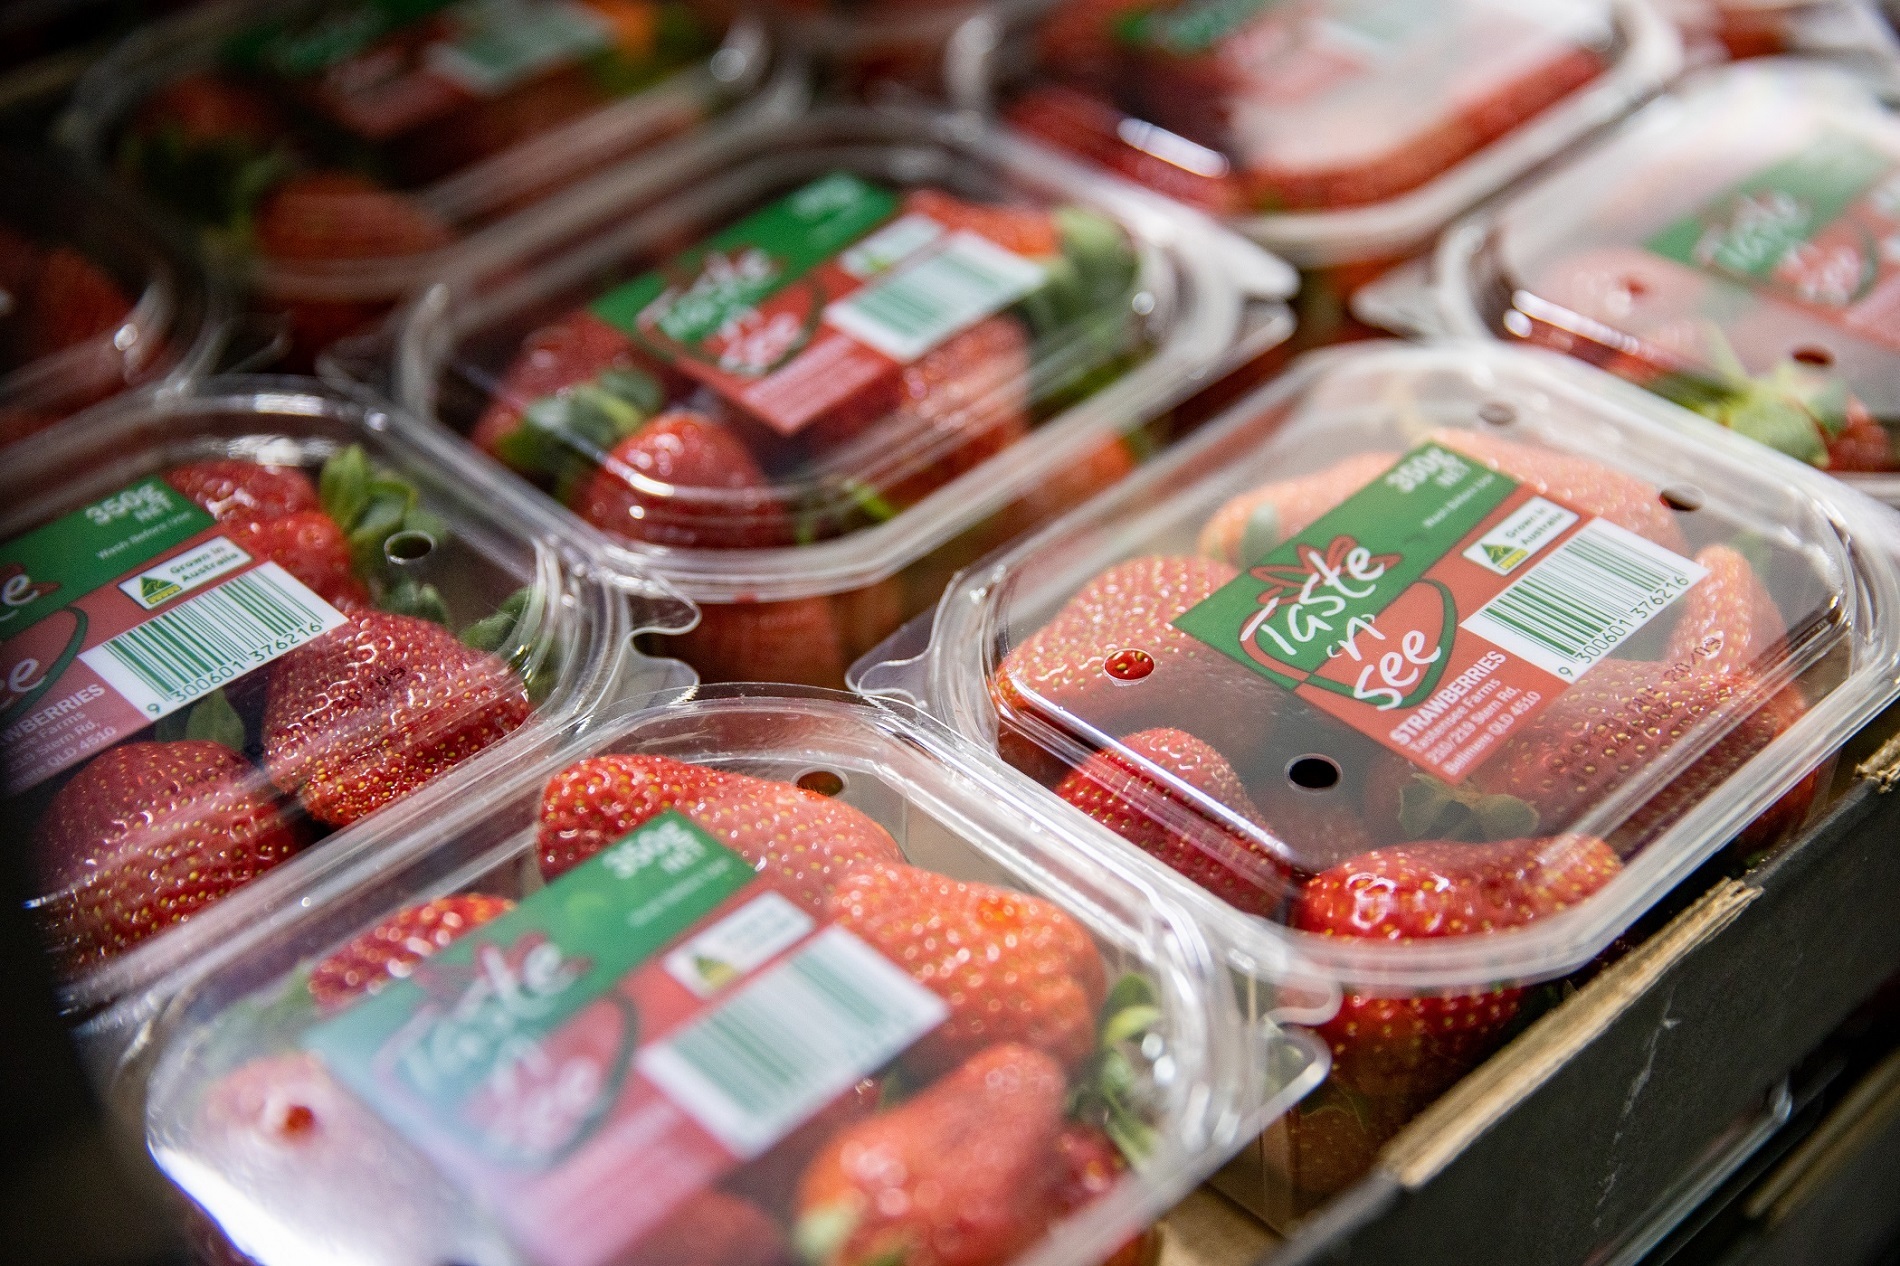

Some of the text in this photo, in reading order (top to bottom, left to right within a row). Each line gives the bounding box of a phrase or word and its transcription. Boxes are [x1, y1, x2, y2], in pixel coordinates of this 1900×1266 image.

[1505, 513, 1537, 540] Grown
[1521, 512, 1566, 546] Australia
[169, 550, 211, 575] Grown
[181, 552, 239, 583] Australia
[1240, 547, 1384, 656] Taste
[1575, 618, 1635, 665] 300601
[1630, 574, 1690, 620] 376216
[171, 660, 246, 704] 300601
[249, 621, 323, 663] 376216
[1389, 650, 1508, 746] STRAWBERRIES
[1462, 678, 1502, 709] Farms
